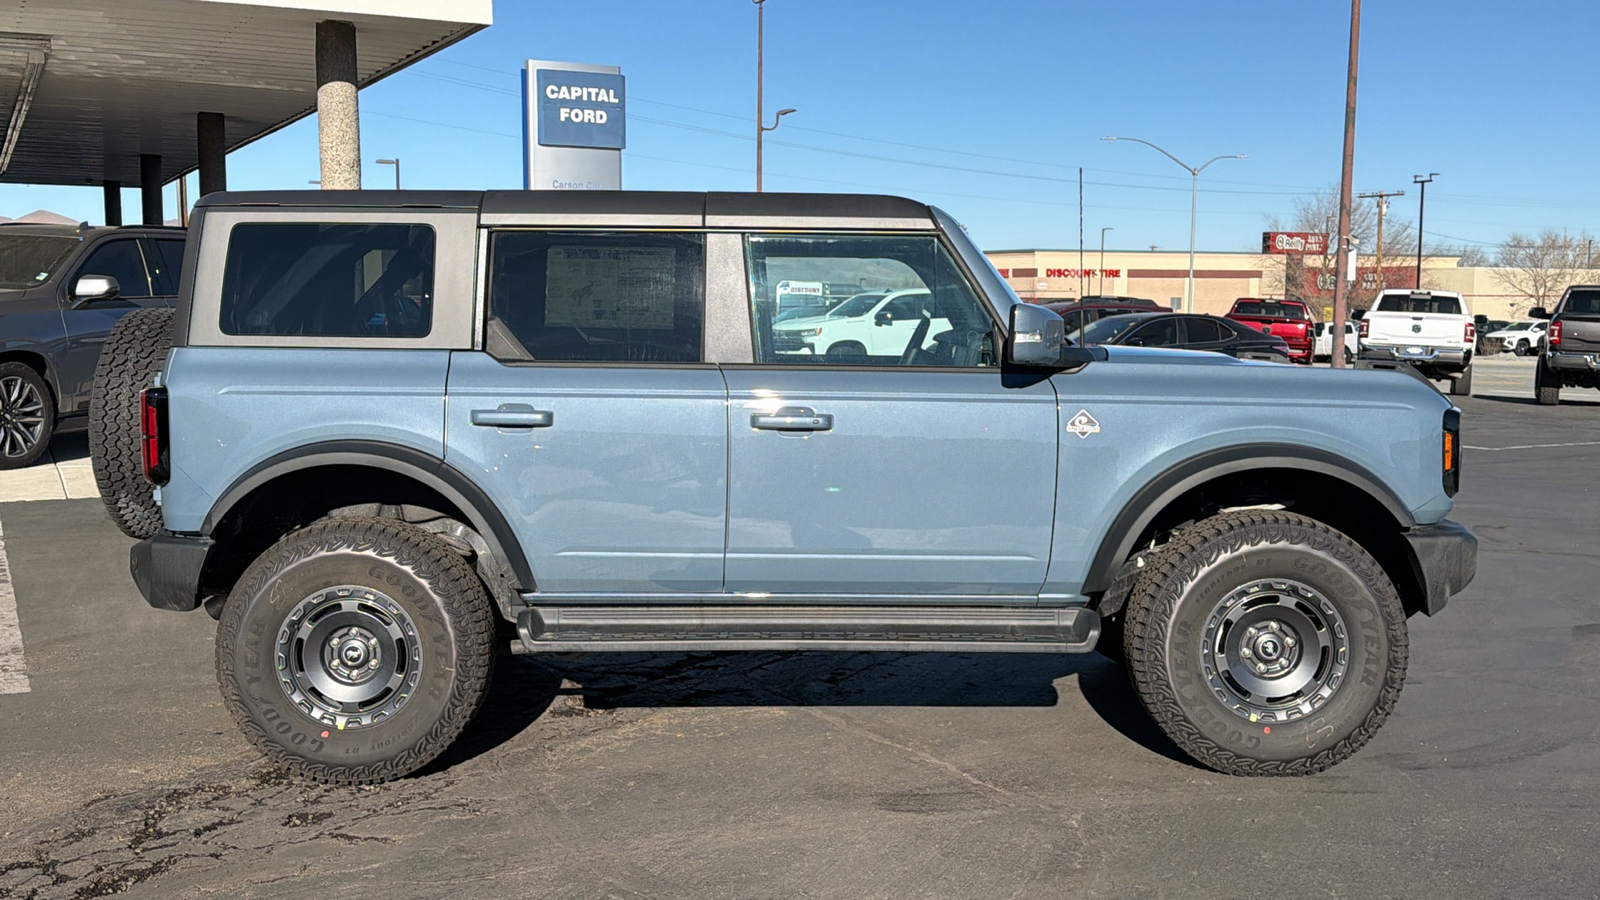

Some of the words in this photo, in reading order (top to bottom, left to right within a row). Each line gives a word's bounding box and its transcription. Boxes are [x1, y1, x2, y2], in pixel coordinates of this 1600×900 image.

[545, 84, 619, 103] CAPITAL
[559, 107, 608, 124] FORD
[552, 179, 584, 189] Carson
[1046, 268, 1098, 278] DISCOUNT
[1099, 268, 1121, 278] TIRE
[1362, 281, 1387, 289] PARS
[1292, 556, 1381, 686] GOODYEAR
[368, 565, 449, 700] GOODYEAR
[244, 619, 325, 752] GOODYEAR
[1174, 620, 1261, 749] GOODYEAR
